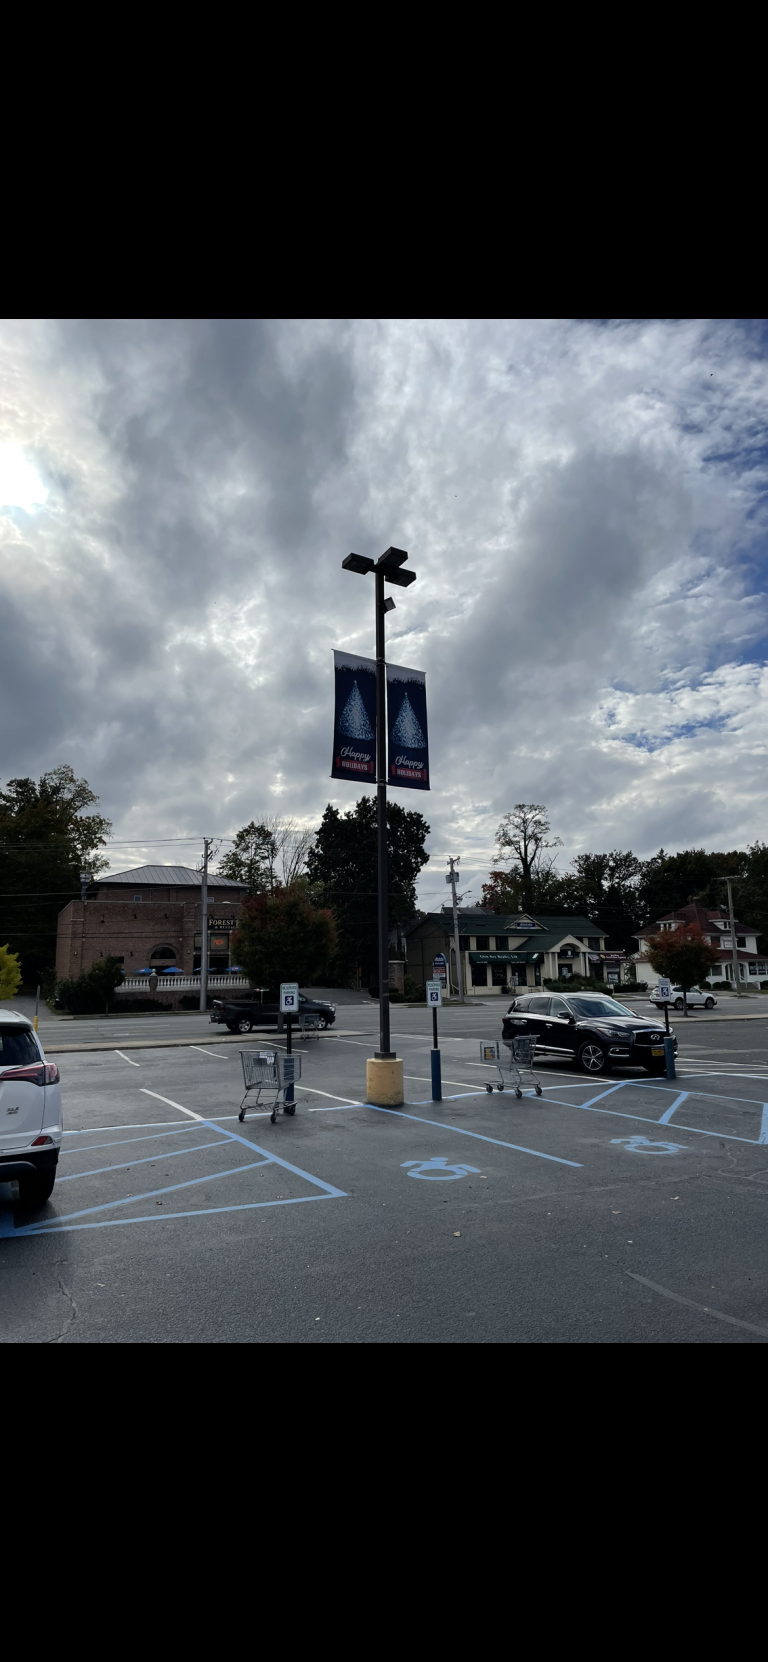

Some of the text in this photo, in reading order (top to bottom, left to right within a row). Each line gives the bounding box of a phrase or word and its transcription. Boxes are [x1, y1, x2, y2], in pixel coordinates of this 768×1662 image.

[340, 746, 371, 762] Happy
[341, 760, 368, 771] HOLIDAYS
[395, 755, 424, 769] Happy
[396, 768, 422, 778] HOLIDAYS
